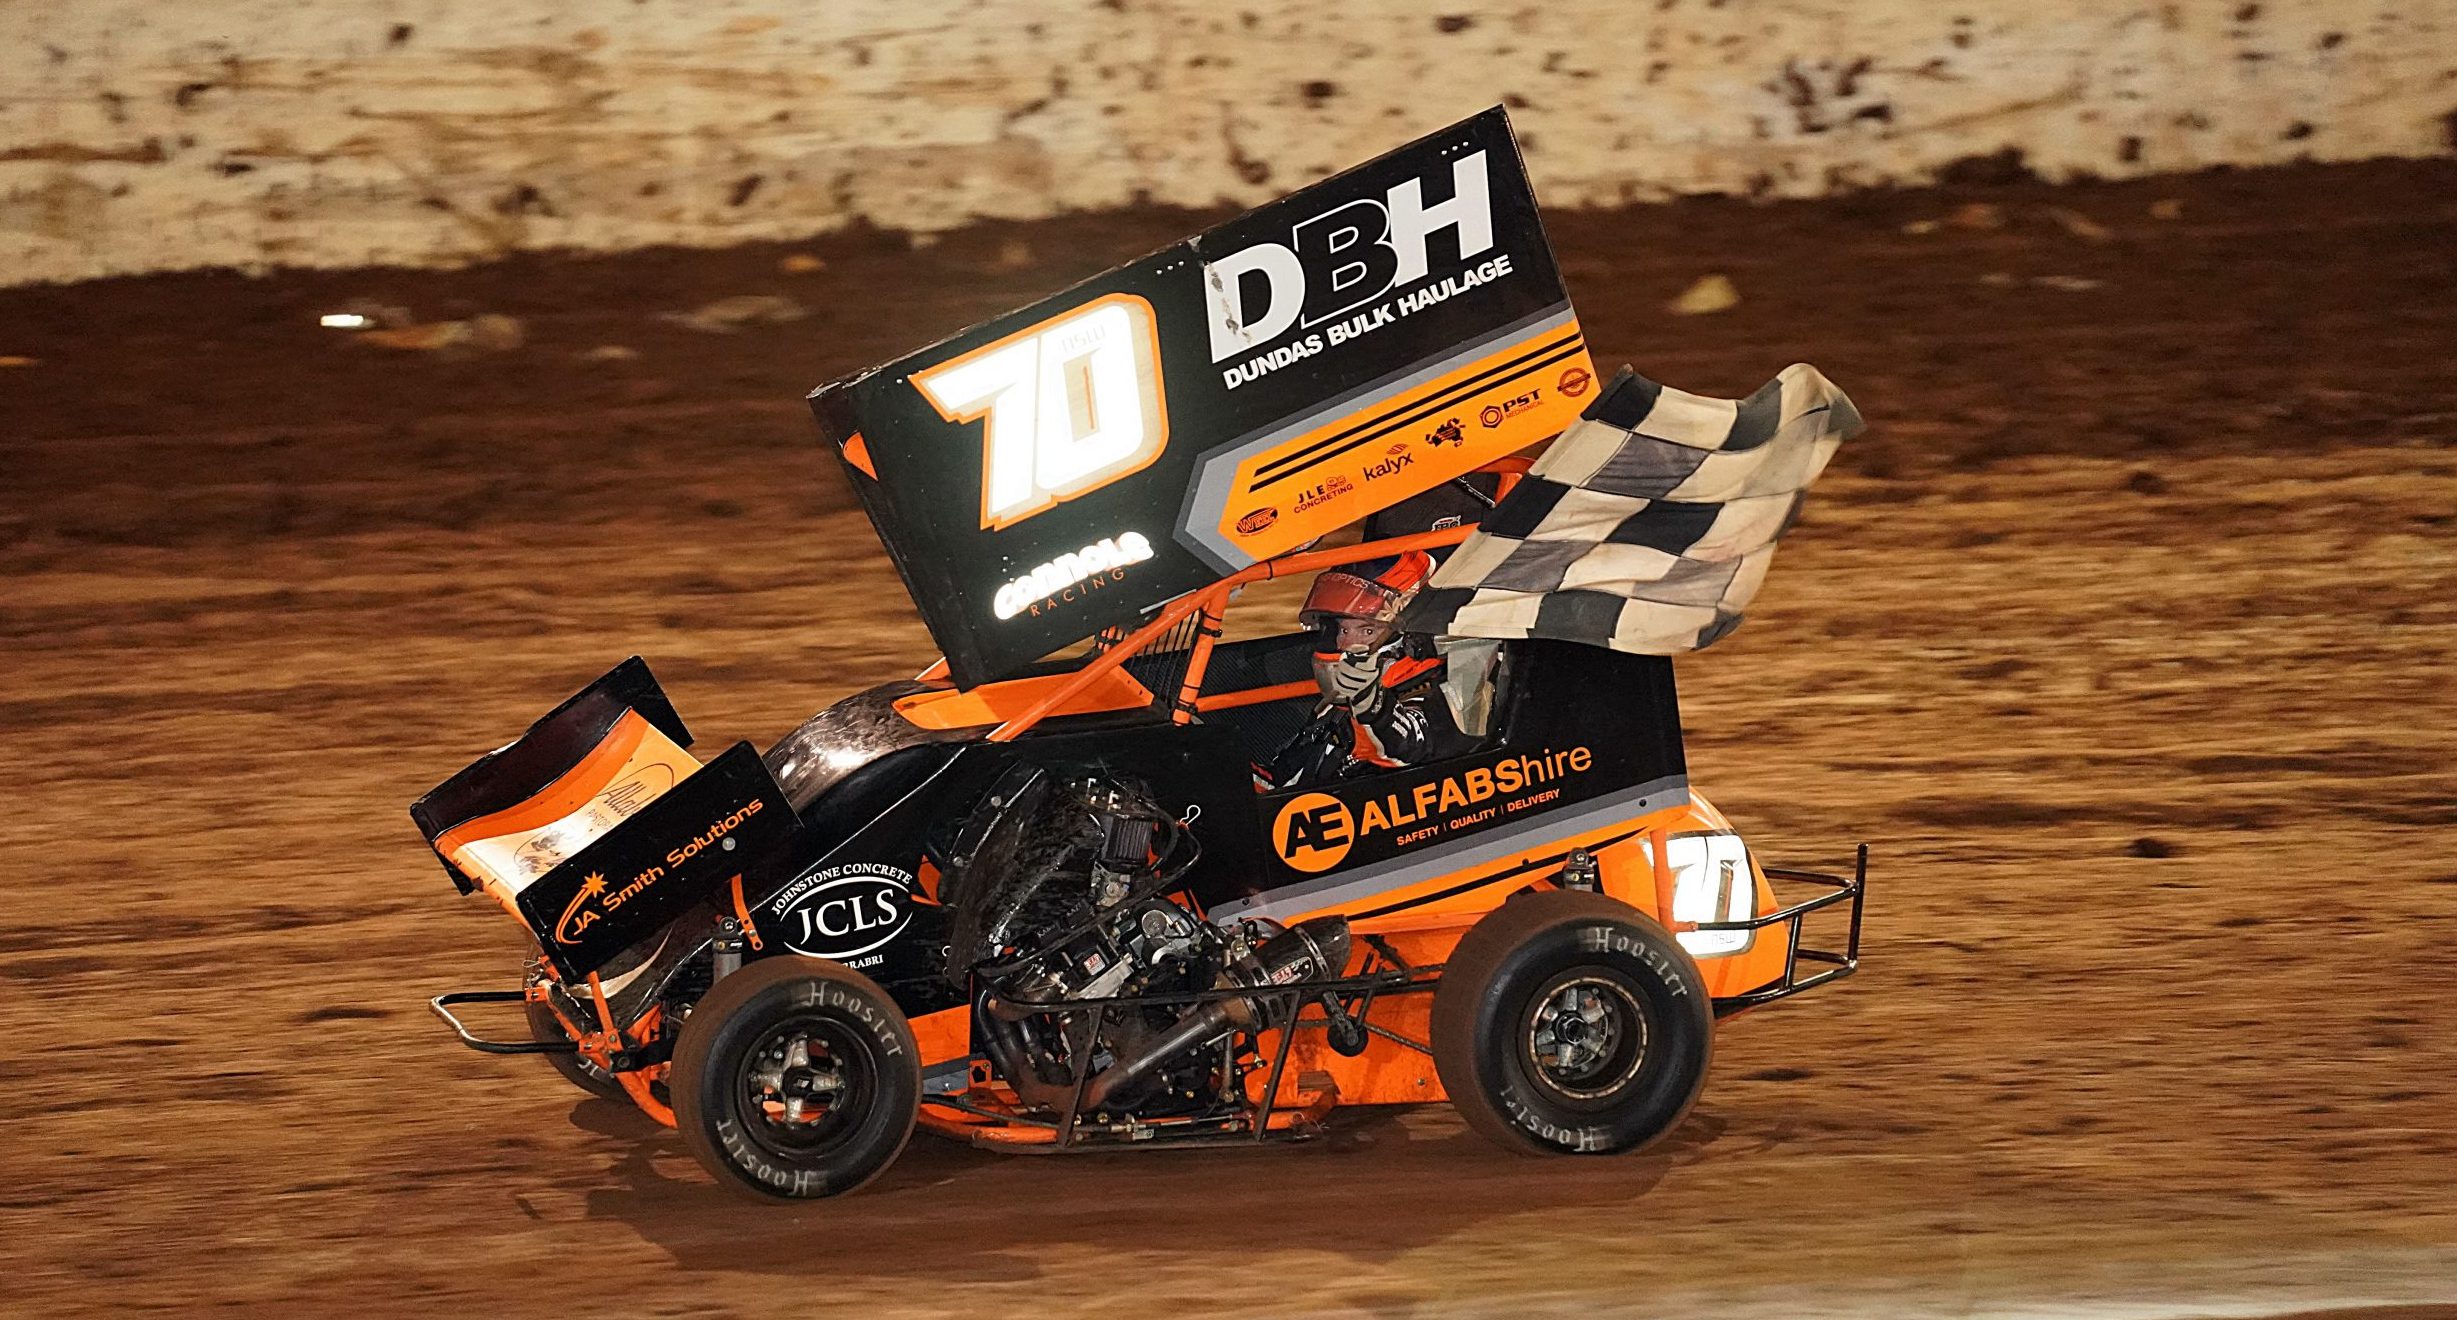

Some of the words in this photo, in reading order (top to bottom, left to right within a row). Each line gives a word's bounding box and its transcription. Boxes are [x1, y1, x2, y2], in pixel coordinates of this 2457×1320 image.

[1203, 149, 1494, 364] DBH
[1222, 334, 1324, 390] DUNDAS
[1326, 303, 1396, 347] BULK
[1397, 254, 1513, 317] HAULAGE
[911, 295, 1166, 530] 70
[1503, 388, 1541, 412] PST
[1506, 400, 1545, 419] MECHANICAL
[1363, 452, 1414, 481] kalyx
[1294, 483, 1354, 513] CONCRETING
[1030, 568, 1125, 617] RACING
[1396, 825, 1439, 846] SAFETY
[1450, 807, 1496, 831] QUALITY
[1507, 788, 1561, 812] DELIVERY
[574, 909, 600, 936] JA
[602, 864, 665, 912] Smith
[666, 798, 764, 868] Solutions
[771, 866, 841, 915] JOHNSTONE
[842, 863, 913, 885] CONCRETE
[797, 888, 898, 945] JCLS
[842, 954, 884, 970] RABRI
[1593, 926, 1688, 997] Hoosier
[802, 981, 903, 1057] Hoosier
